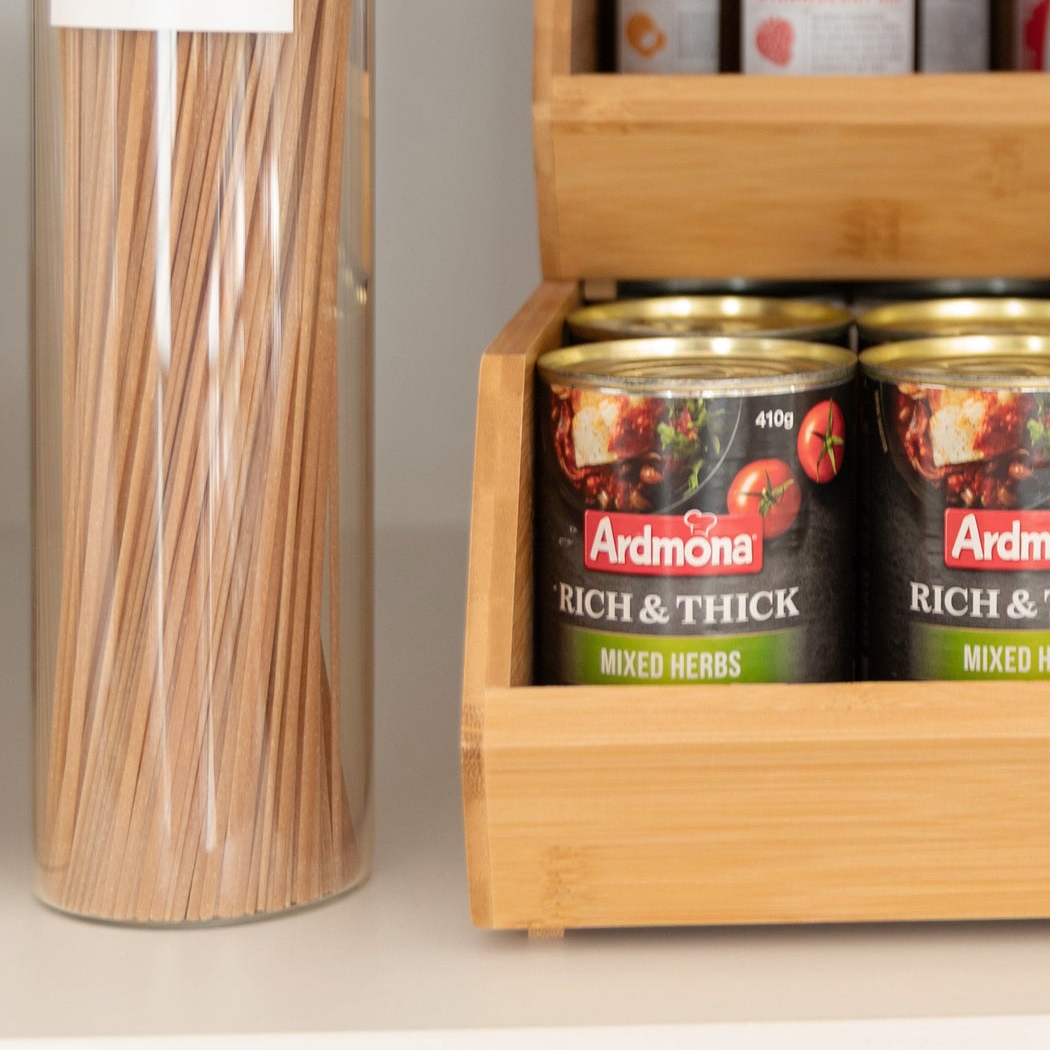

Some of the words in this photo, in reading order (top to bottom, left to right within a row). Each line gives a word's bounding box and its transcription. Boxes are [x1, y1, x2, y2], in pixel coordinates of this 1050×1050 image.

[755, 409, 794, 430] 410g
[590, 516, 752, 567] Ardmona
[559, 582, 633, 622] RICH
[639, 594, 670, 624] &
[676, 586, 800, 625] THICK
[910, 582, 1001, 618] RICH
[1007, 589, 1038, 619] &
[601, 647, 663, 678] MIXED
[671, 648, 742, 680] HERBS
[964, 643, 1031, 673] MIXED
